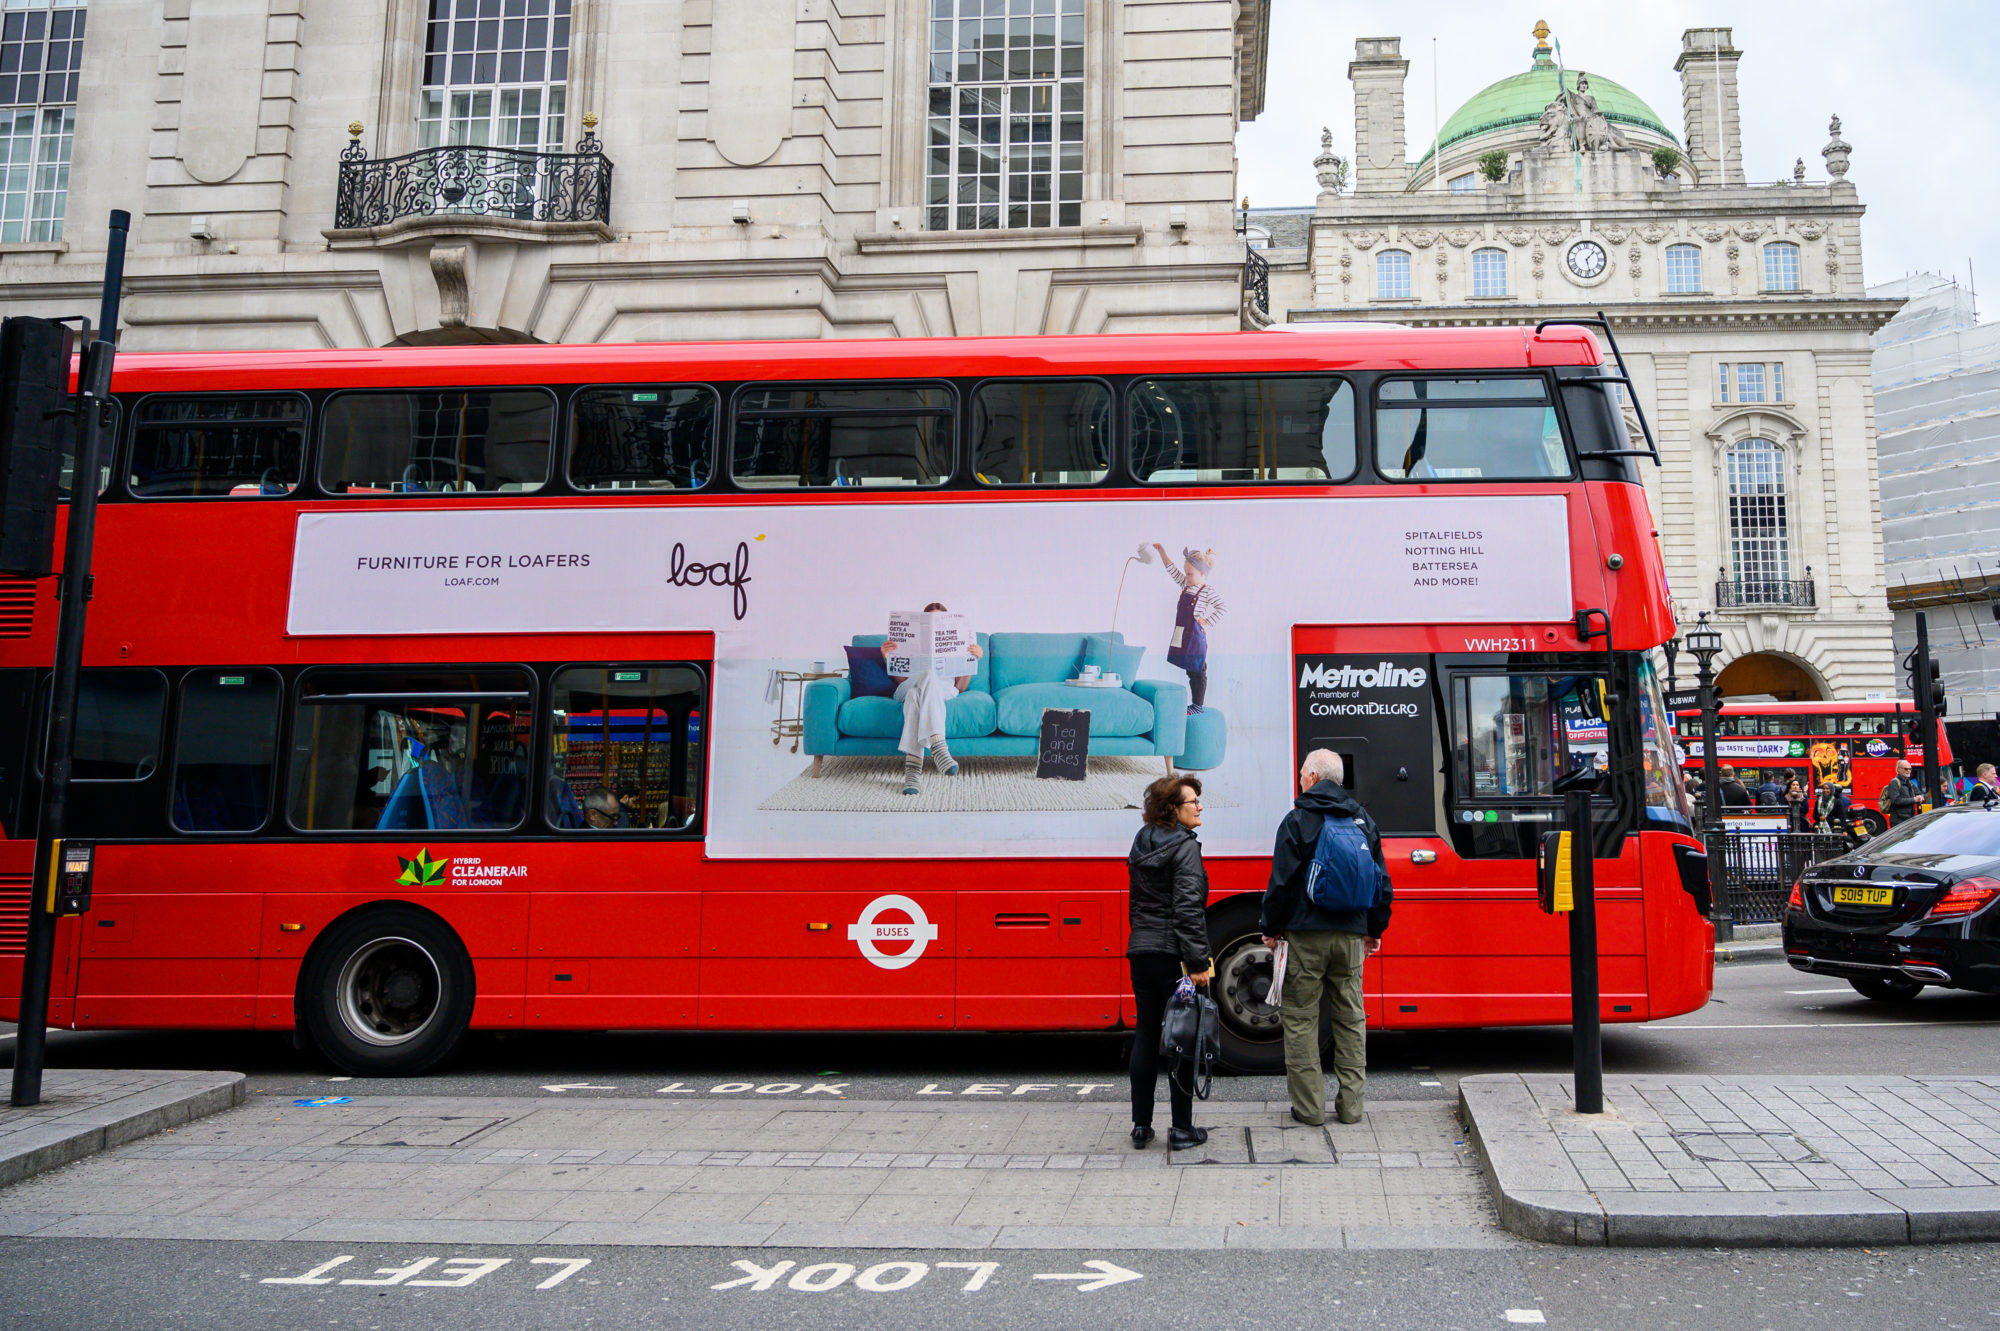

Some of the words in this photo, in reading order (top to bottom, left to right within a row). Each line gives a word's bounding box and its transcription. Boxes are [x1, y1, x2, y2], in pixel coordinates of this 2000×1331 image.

[1405, 531, 1483, 541] SPITALFIELDS
[1405, 546, 1456, 556] NOTTING
[1459, 546, 1485, 555] HILL
[357, 555, 459, 570] FURNITURE
[465, 555, 502, 569] FOR
[508, 553, 591, 568] LOAFERS
[1412, 561, 1479, 571] BATTERSEA
[444, 577, 499, 587] LOAF.COM
[667, 542, 752, 621] loaf
[1413, 577, 1439, 587] AND
[1442, 577, 1479, 586] MORE!
[1682, 614, 1750, 622] ALIANCE
[1464, 638, 1536, 651] VWH2311
[1299, 661, 1427, 689] Metroline
[1309, 690, 1316, 699] A
[1317, 690, 1349, 699] member
[1351, 689, 1360, 698] of
[1669, 695, 1697, 705] SUBWAY
[1051, 723, 1076, 738] Tea
[1050, 739, 1075, 751] and
[1042, 750, 1081, 766] Cakes
[67, 861, 88, 872] WAIT
[453, 857, 481, 865] HYBRID
[1840, 888, 1863, 901] SO19
[1866, 890, 1887, 903] TUP
[876, 927, 909, 937] BUSES
[656, 1082, 851, 1095] LOOK
[916, 1083, 1115, 1095] LEFT
[258, 1255, 592, 1290] LEFT
[710, 1259, 1000, 1292] LOOK
